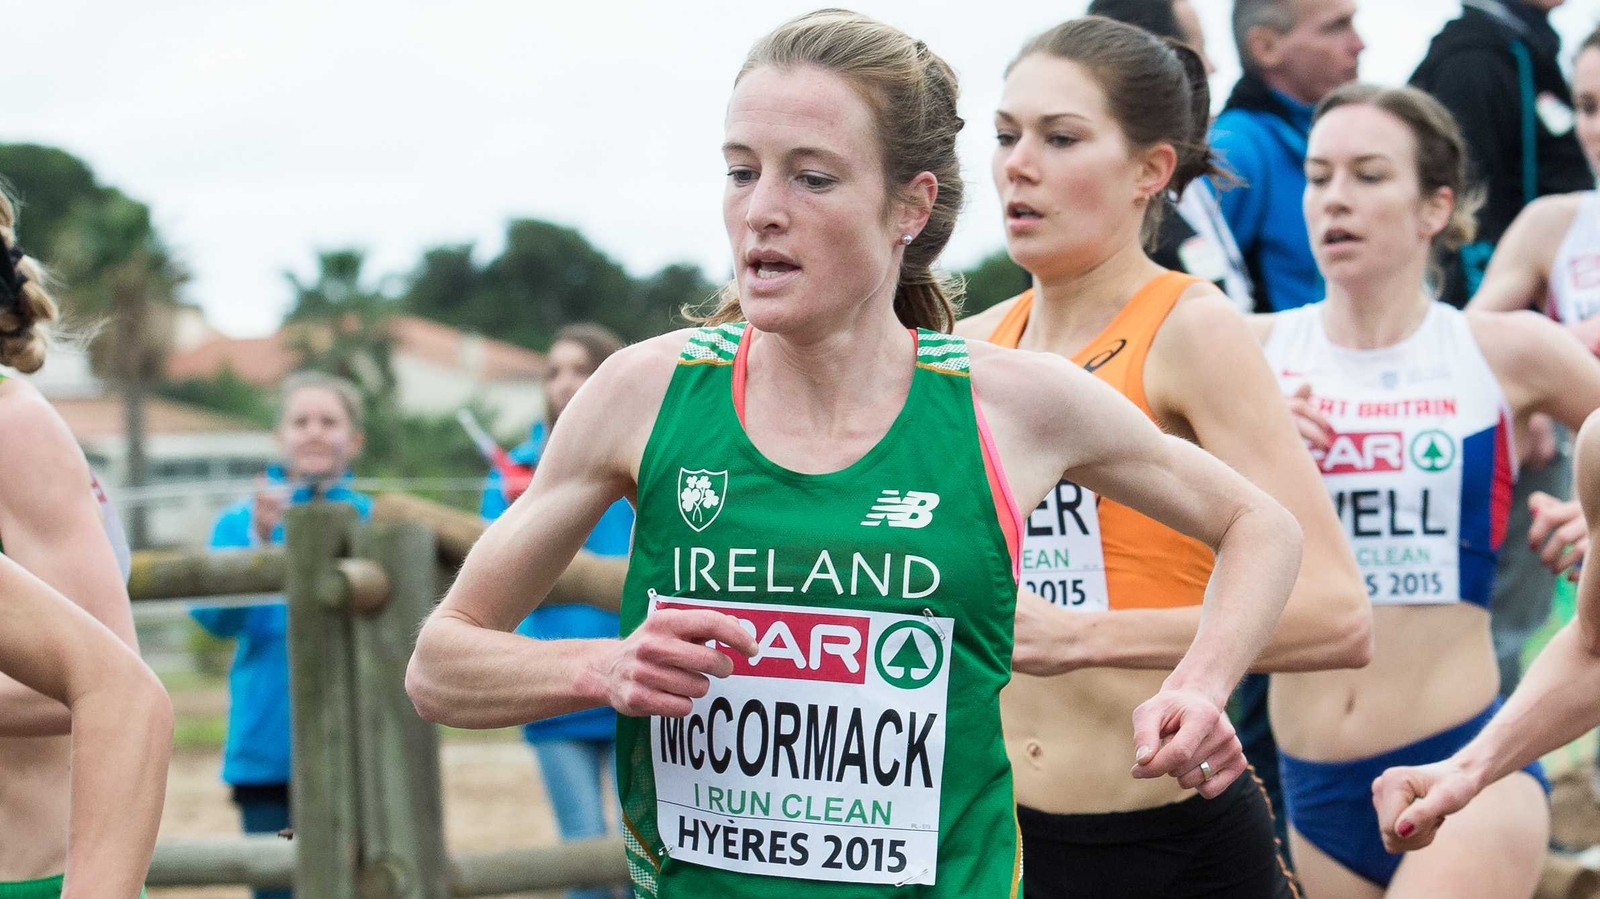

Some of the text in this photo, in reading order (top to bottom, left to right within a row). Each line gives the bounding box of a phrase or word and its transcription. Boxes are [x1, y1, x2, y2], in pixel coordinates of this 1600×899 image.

[1312, 435, 1401, 470] AR
[673, 546, 941, 598] IRELAND
[1356, 547, 1431, 567] CLEAN
[1389, 573, 1443, 597] 2015
[710, 617, 860, 674] AR
[660, 696, 938, 789] McCORMACK
[694, 783, 892, 826] I RUN CLEAN
[677, 815, 907, 873] HYÈRES 2015
